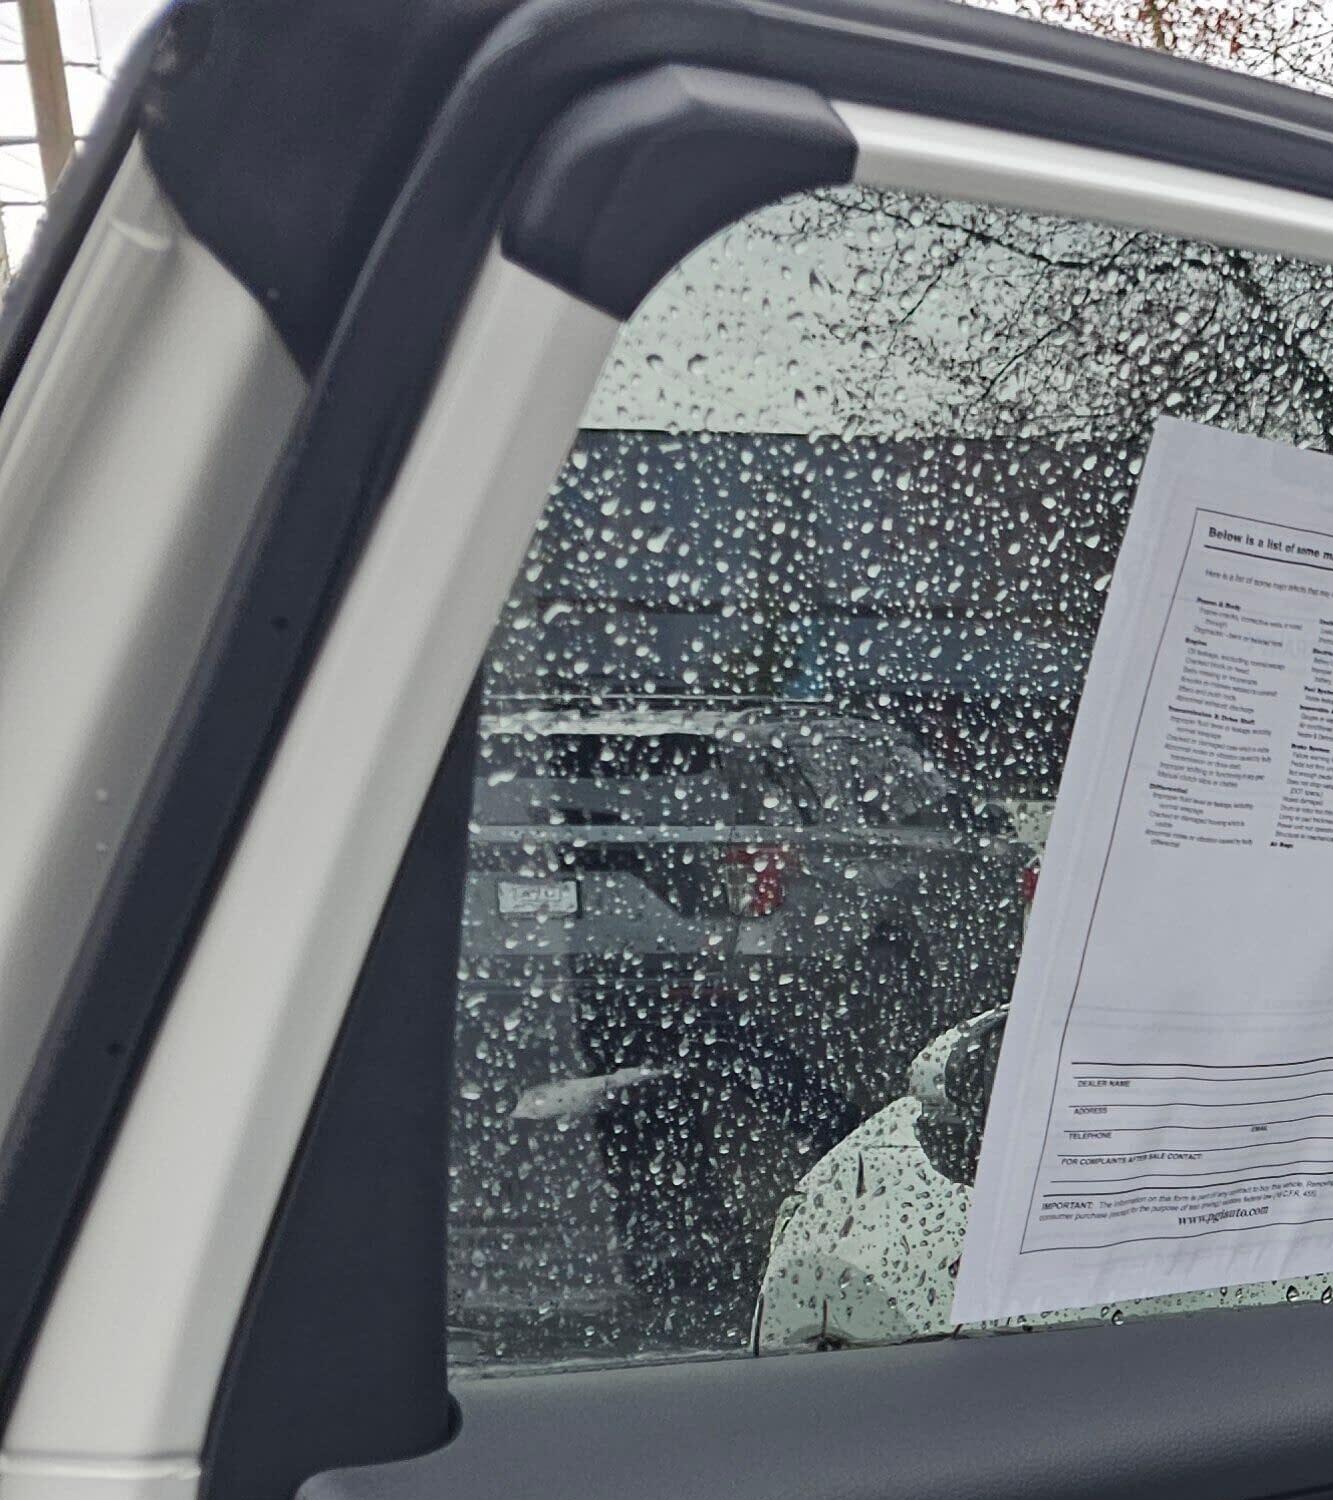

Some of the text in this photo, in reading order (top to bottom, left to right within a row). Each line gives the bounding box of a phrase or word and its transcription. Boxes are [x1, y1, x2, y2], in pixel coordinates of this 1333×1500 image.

[1208, 527, 1243, 542] Below
[1245, 534, 1255, 545] is
[1258, 539, 1264, 547] a
[1267, 539, 1283, 550] list
[1285, 543, 1295, 553] of
[1296, 546, 1320, 558] some
[1077, 1080, 1132, 1088] DEALER NAME
[1073, 1107, 1108, 1115] ADDRESS
[1068, 1132, 1113, 1140] TELEPHONE
[1061, 1158, 1079, 1166] FOR
[1079, 1157, 1127, 1166] COMPLAINTS
[1128, 1154, 1148, 1164] AFTER
[1148, 1152, 1166, 1161] SALE
[1041, 1201, 1095, 1211] IMPORTANT:
